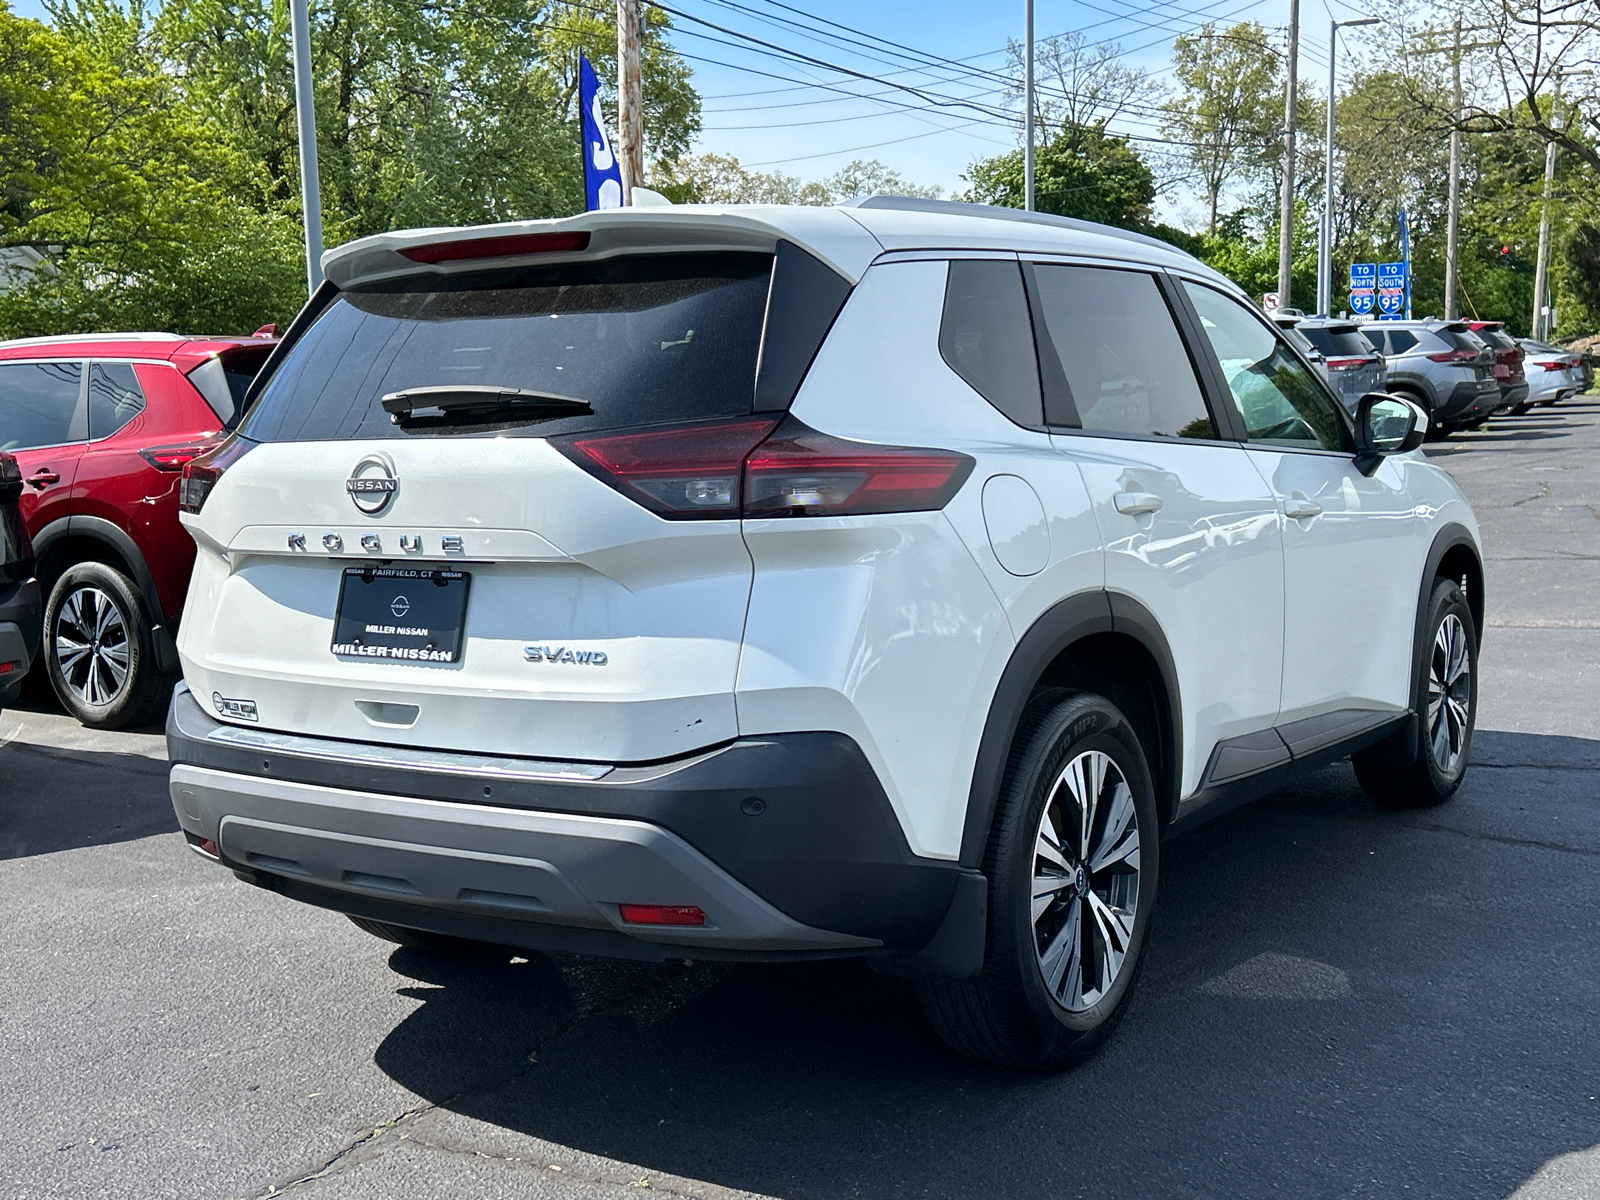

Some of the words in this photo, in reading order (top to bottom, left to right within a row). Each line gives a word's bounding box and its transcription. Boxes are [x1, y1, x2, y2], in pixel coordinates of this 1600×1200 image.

[1357, 266, 1369, 275] TO
[1385, 266, 1397, 274] TO
[1352, 278, 1374, 287] NORTH
[1379, 278, 1402, 287] SOUTH
[1353, 297, 1371, 310] 95
[1382, 297, 1399, 310] 95
[346, 480, 395, 491] NISSAN
[287, 531, 464, 552] ROGUE
[372, 569, 419, 578] FAIRFIELD,
[420, 570, 433, 578] CT
[365, 624, 396, 635] MILLER
[396, 626, 429, 637] NISSAN
[332, 643, 387, 657] MILLER
[390, 648, 453, 662] NISSAN
[1073, 714, 1098, 737] HP2
